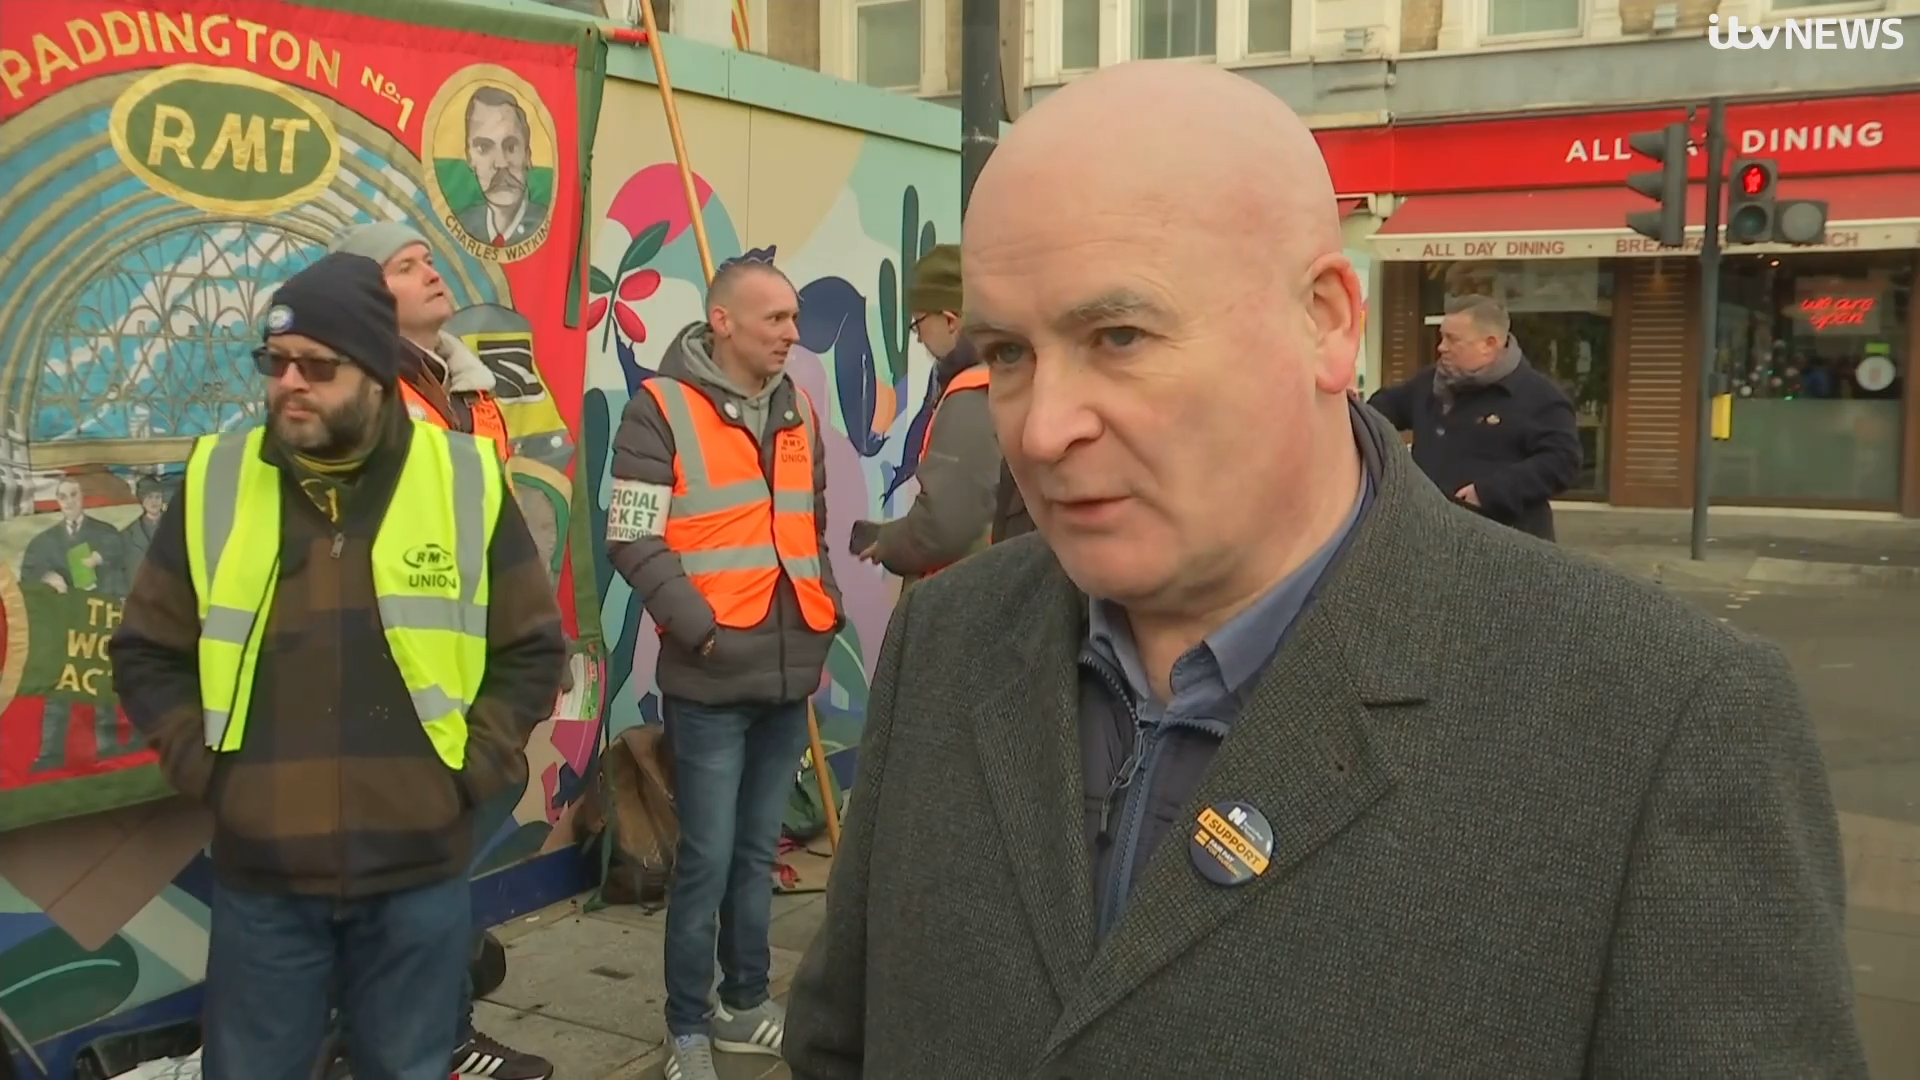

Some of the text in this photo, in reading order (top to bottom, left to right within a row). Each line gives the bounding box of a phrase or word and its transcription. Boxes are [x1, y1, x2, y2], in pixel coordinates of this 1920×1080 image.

[0, 11, 340, 99] PADDINGTON
[147, 103, 311, 175] RMT
[1565, 137, 1632, 163] ALL
[1741, 120, 1884, 154] DINING
[445, 215, 500, 261] CHARLES
[1422, 240, 1565, 257] ALL DAY DINING
[781, 453, 808, 463] UNION
[409, 574, 457, 589] UNION
[87, 597, 126, 629] TH
[1203, 813, 1211, 822] I
[1208, 819, 1262, 866] SUPPORT
